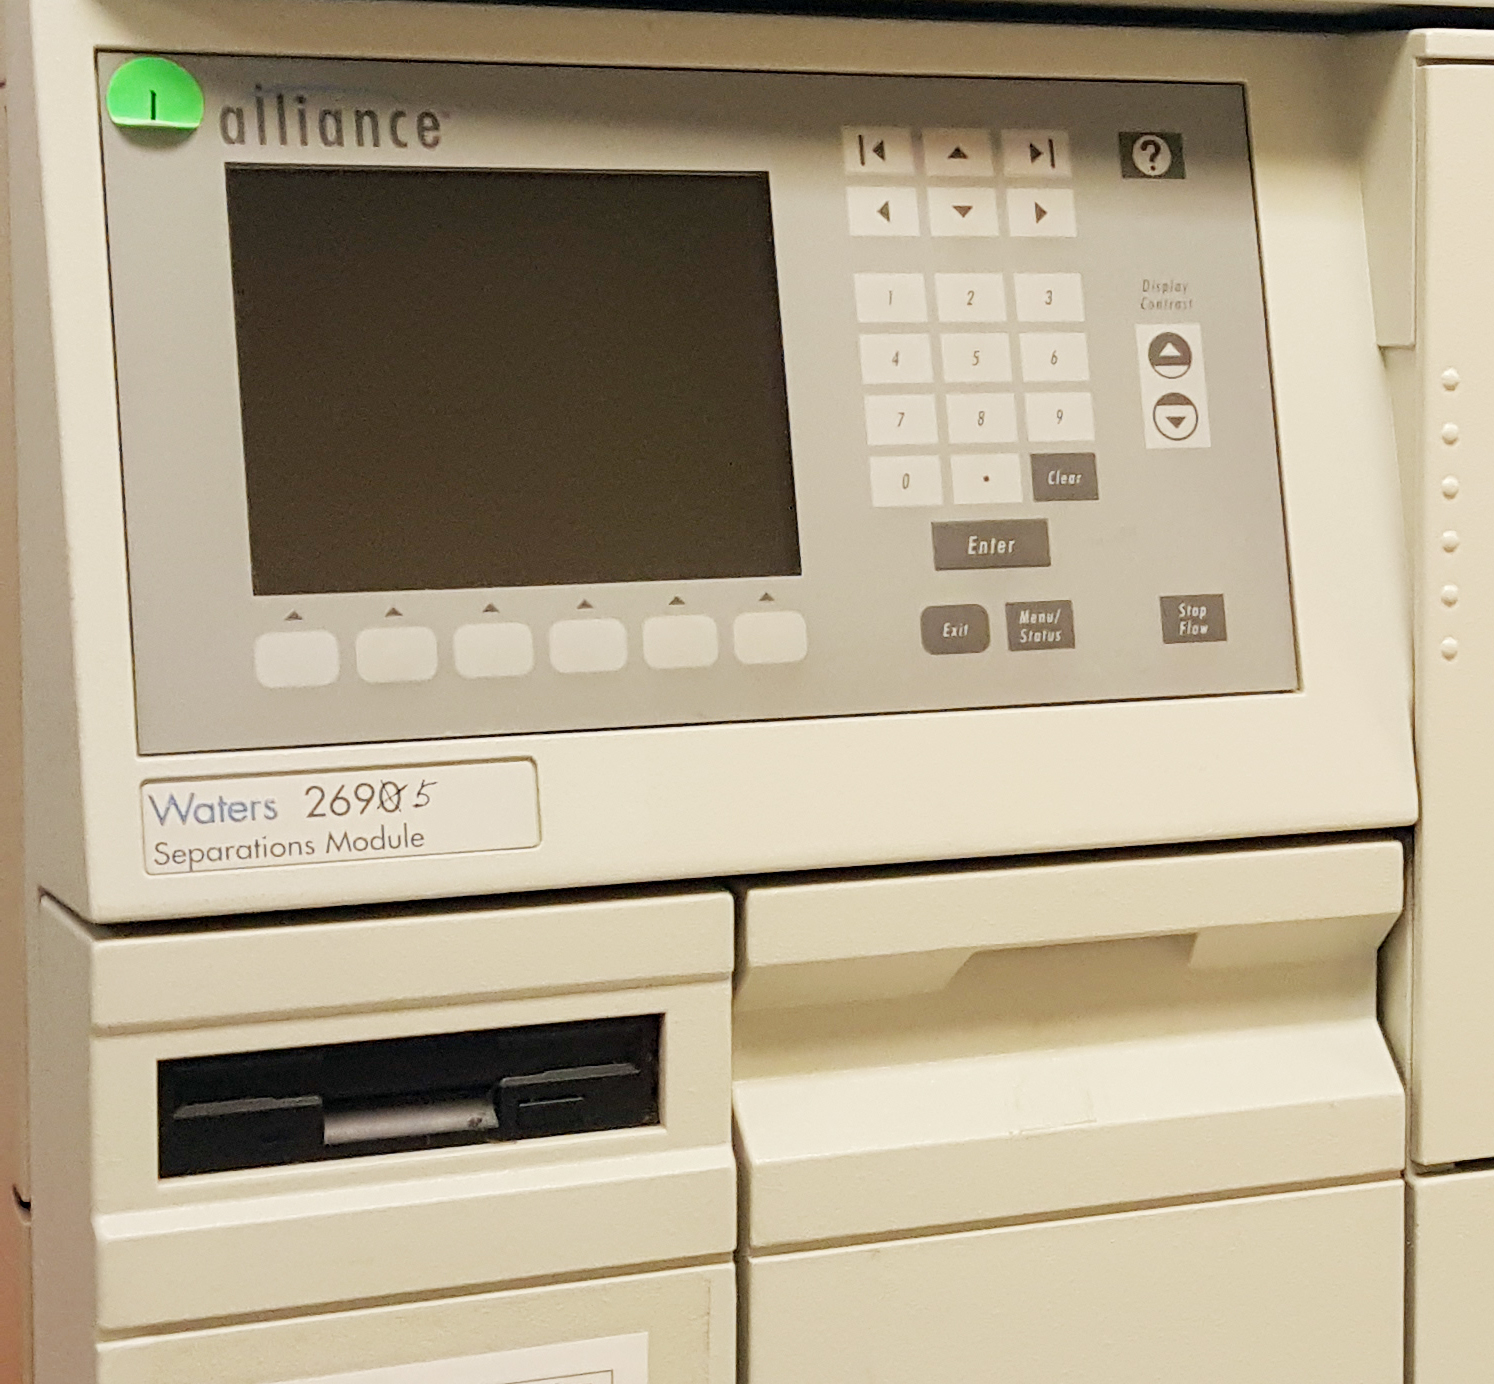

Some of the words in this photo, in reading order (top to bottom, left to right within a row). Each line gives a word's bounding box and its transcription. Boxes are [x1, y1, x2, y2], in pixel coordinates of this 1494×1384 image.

[218, 82, 444, 150] alliance
[1141, 278, 1189, 296] Display
[887, 289, 894, 307] 1
[965, 289, 976, 307] 2
[1044, 289, 1053, 306] 3
[1140, 295, 1194, 312] Contrast
[890, 349, 900, 367] 4
[971, 349, 981, 367] 5
[1050, 349, 1059, 366] 6
[896, 410, 905, 428] 7
[976, 410, 985, 427] 8
[1055, 408, 1064, 425] 9
[901, 473, 910, 491] 0
[1046, 468, 1083, 487] Clear
[966, 535, 1017, 556] Enter
[1019, 608, 1061, 628] Menu/
[1178, 601, 1208, 620] Stop
[941, 621, 970, 639] Exit
[1019, 627, 1063, 644] Status
[1178, 620, 1209, 637] Flow
[147, 792, 279, 827] Waters
[153, 835, 316, 873] Separations
[324, 822, 426, 854] Module
